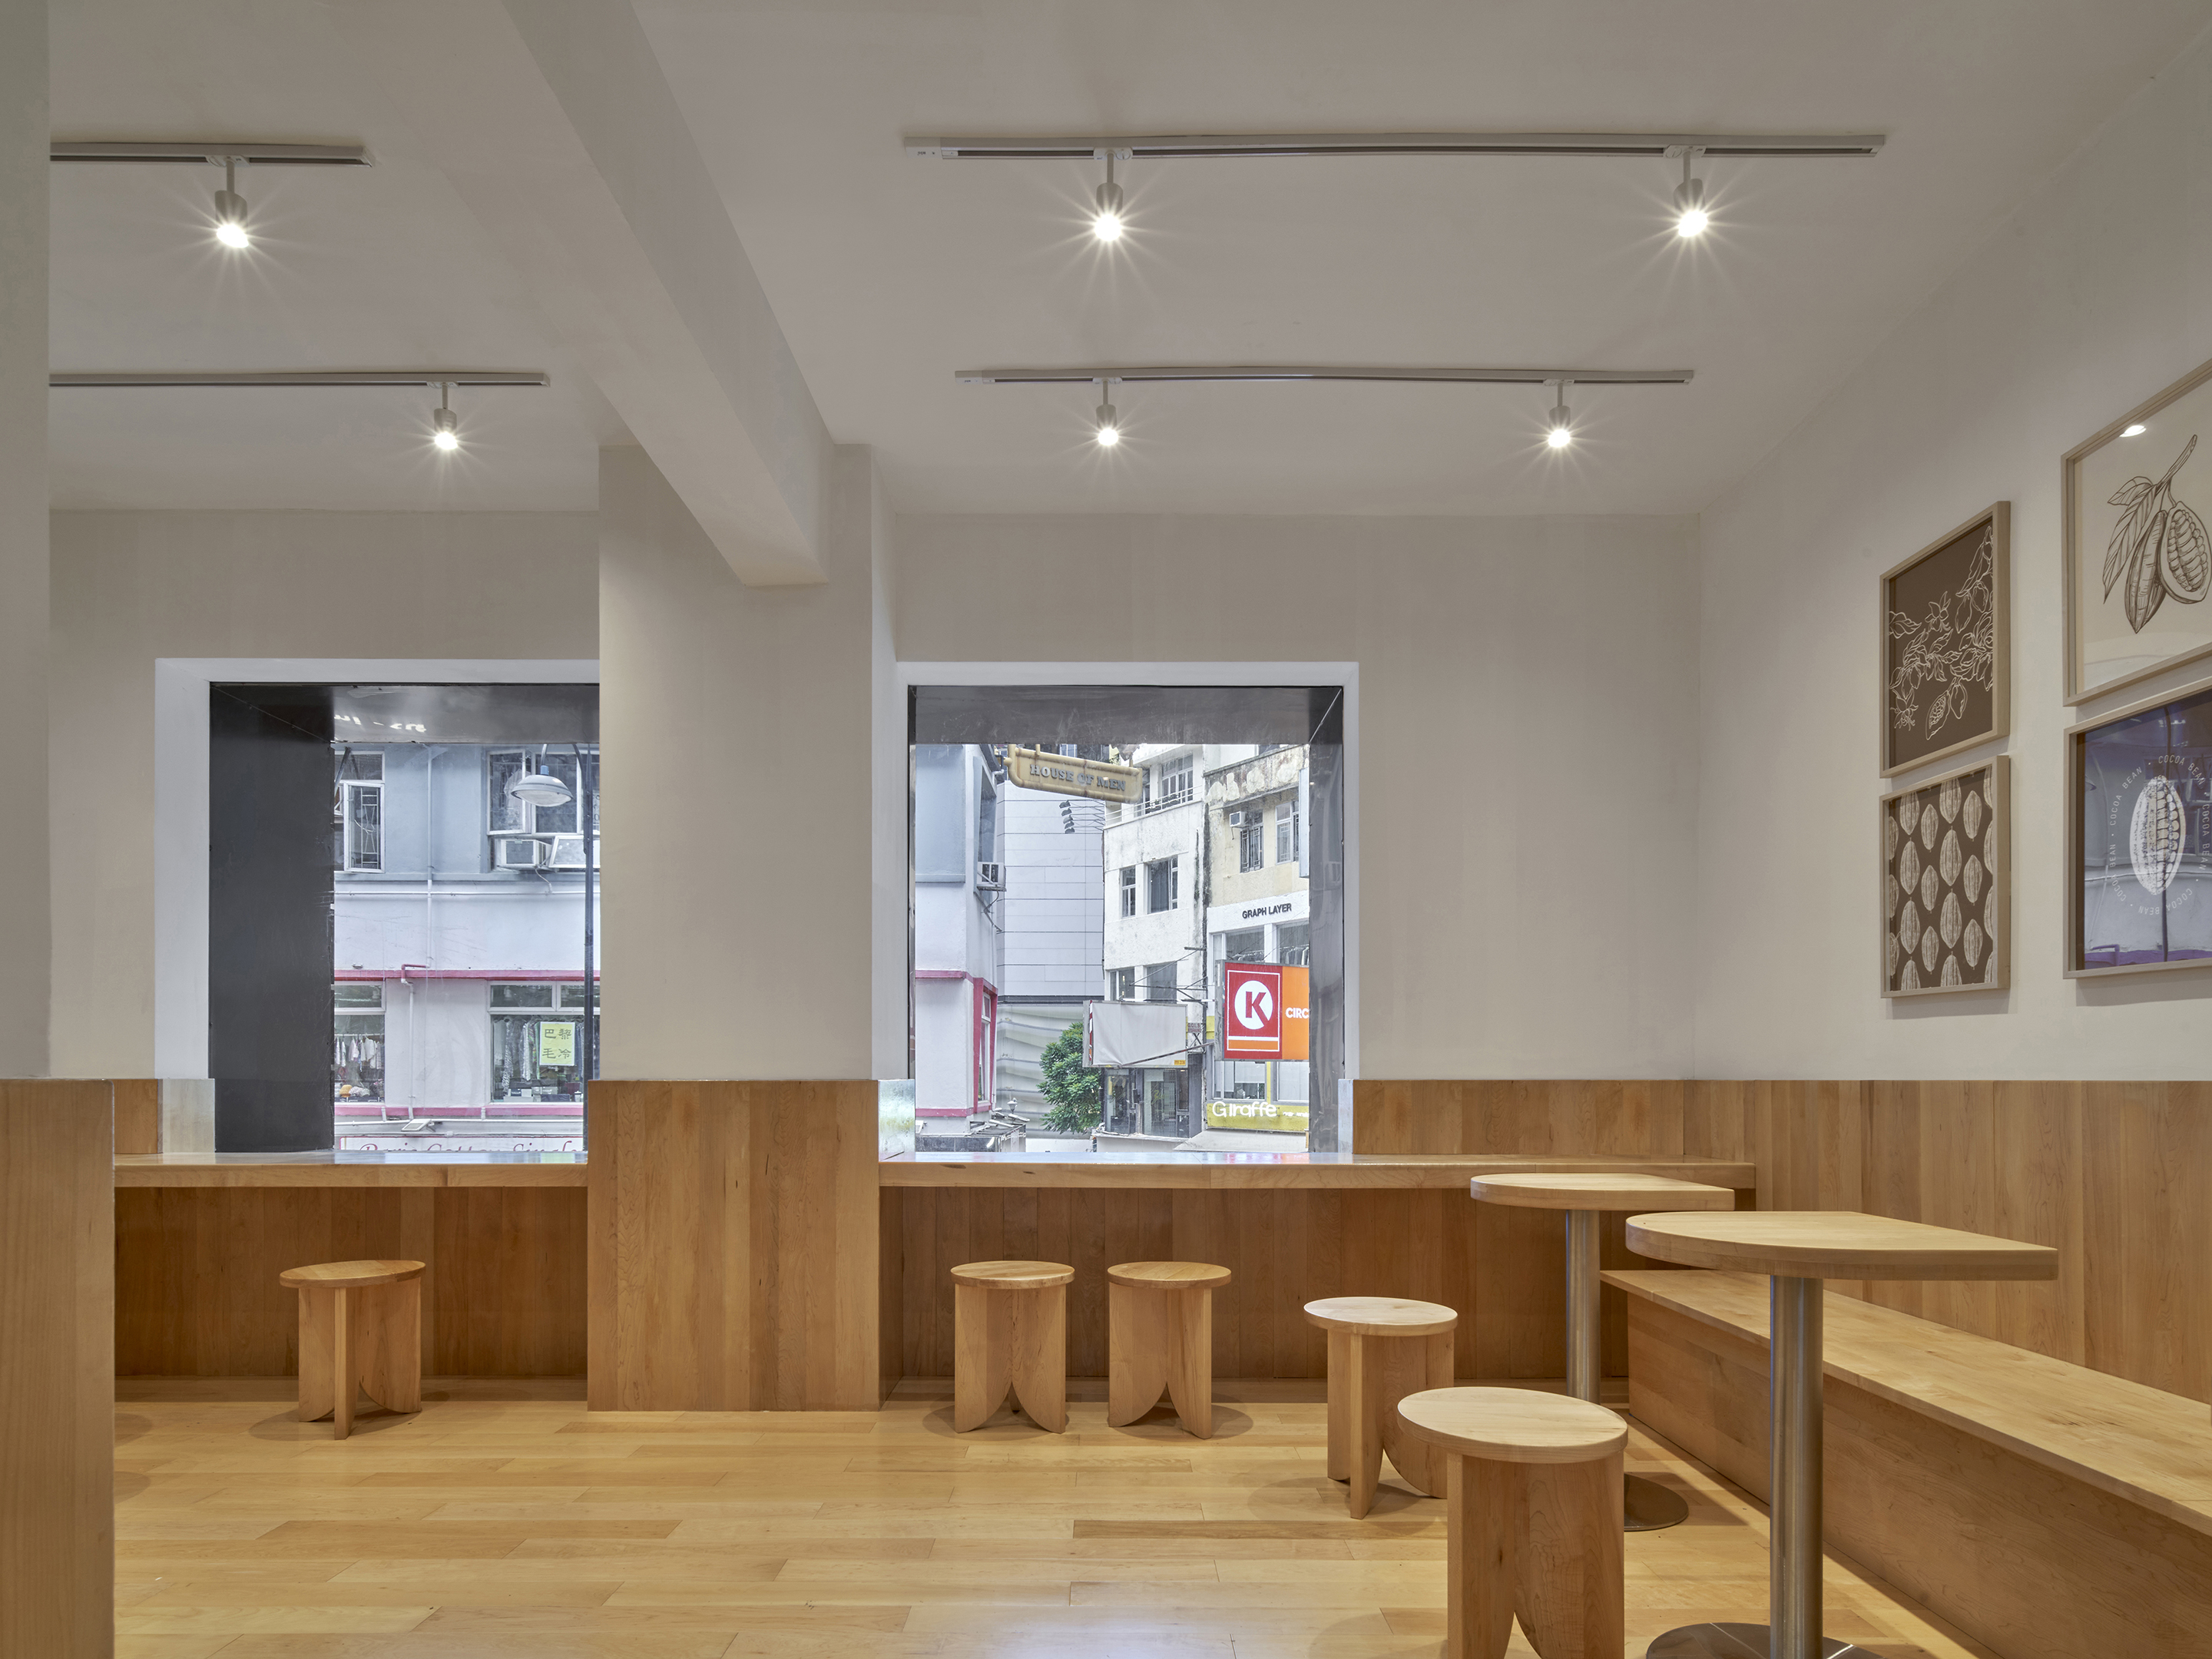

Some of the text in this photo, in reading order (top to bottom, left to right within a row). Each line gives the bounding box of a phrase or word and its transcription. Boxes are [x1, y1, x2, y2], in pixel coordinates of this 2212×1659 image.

[1030, 764, 1126, 791] HOUSE OF MEN
[2158, 754, 2205, 786] COCOA BEAN
[2109, 767, 2142, 826] COCOA BEAN
[2199, 804, 2210, 870] COCOA BEAN
[1242, 903, 1292, 919] GRAPH LAYER
[2138, 888, 2193, 916] COCOA BEAN
[1245, 991, 1270, 1026] K
[545, 1028, 571, 1040] 巴黎
[542, 1048, 571, 1059] 毛冷
[1212, 1101, 1277, 1118] Giraffe
